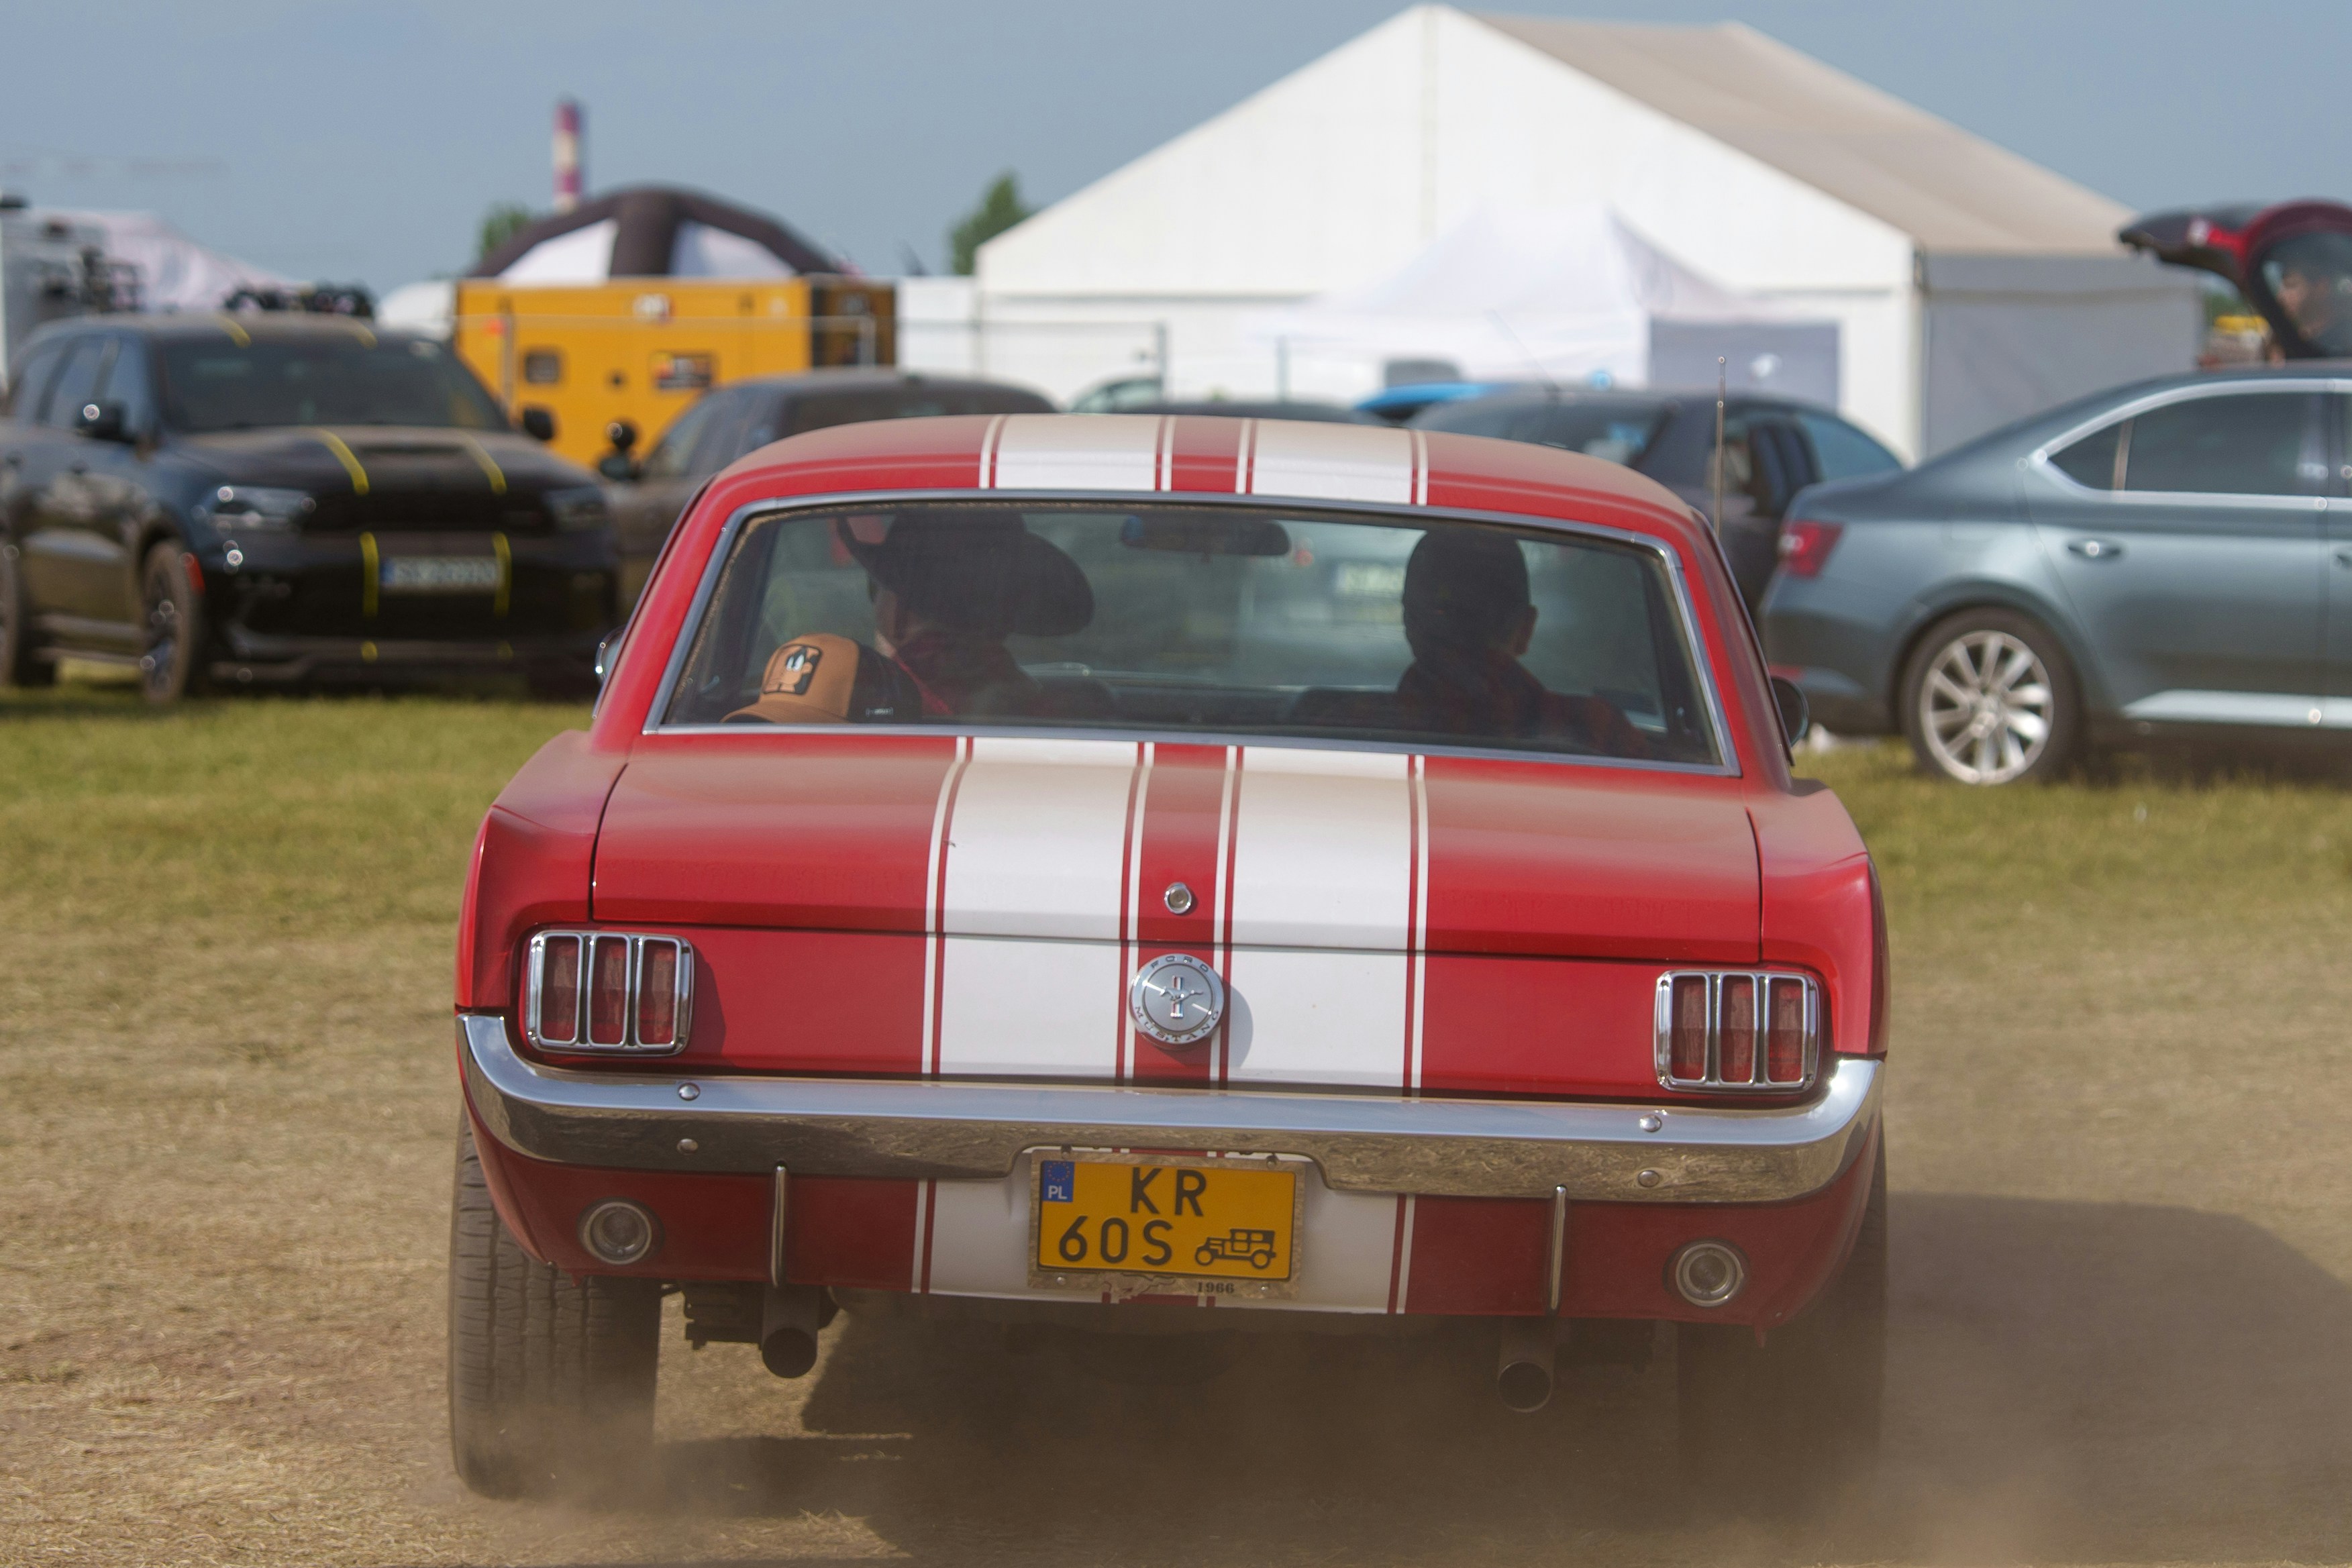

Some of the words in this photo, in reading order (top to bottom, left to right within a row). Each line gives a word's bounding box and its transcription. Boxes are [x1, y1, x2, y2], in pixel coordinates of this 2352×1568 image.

[1151, 955, 1209, 973] FORD
[1135, 1006, 1219, 1042] MUSTANG
[1048, 1185, 1067, 1200] PL
[1130, 1167, 1207, 1217] KR
[1058, 1215, 1174, 1266] 60S
[1197, 1282, 1235, 1294] 1966
